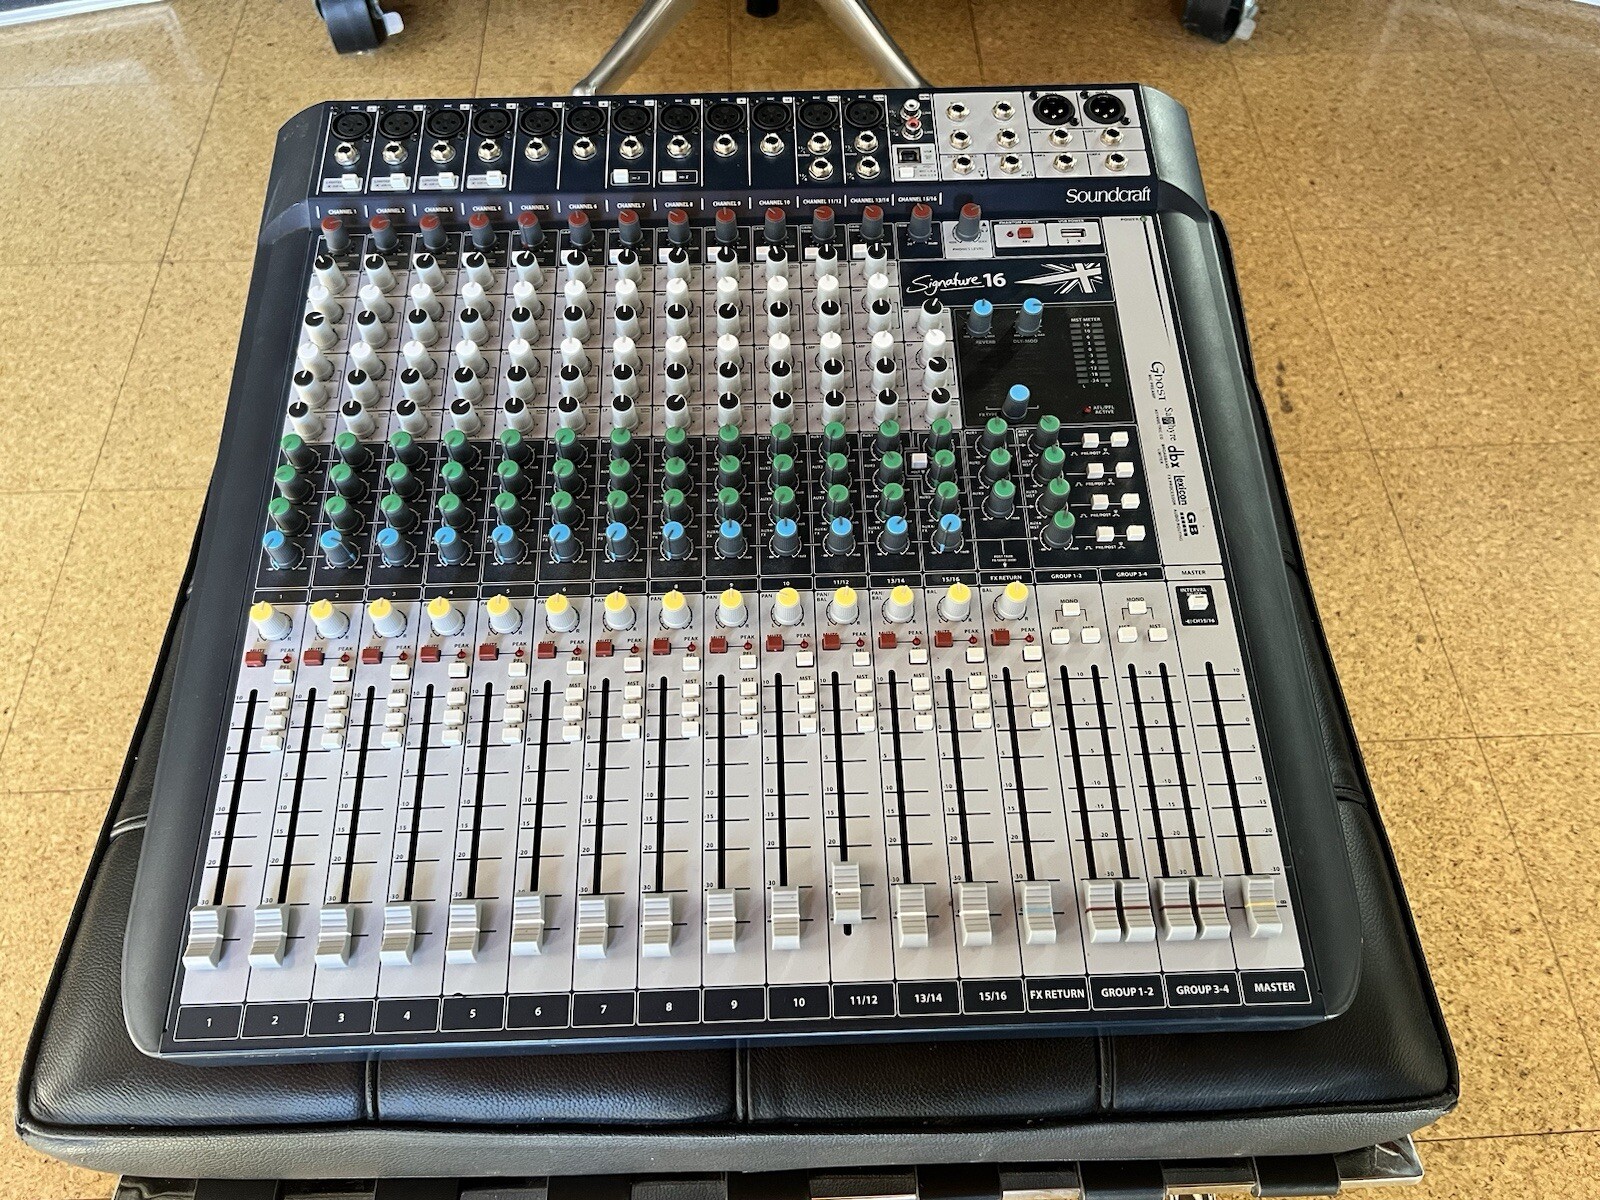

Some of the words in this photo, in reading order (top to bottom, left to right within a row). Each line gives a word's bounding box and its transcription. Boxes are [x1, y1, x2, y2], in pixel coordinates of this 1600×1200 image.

[1065, 186, 1151, 204] Soundcraft
[906, 273, 985, 296] Signature
[983, 273, 1006, 288] 16
[1168, 446, 1185, 468] dbx
[1174, 475, 1187, 505] lexicon
[1187, 512, 1199, 535] GB
[1101, 987, 1136, 997] GROUP
[1138, 987, 1154, 996] 1-2
[1176, 985, 1212, 995] GROUP
[1214, 984, 1229, 994] 3-4
[1254, 982, 1295, 992] MASTER
[914, 993, 942, 1003] 13/14
[979, 991, 1007, 1001] 15/16
[1030, 990, 1043, 999] FX
[1045, 989, 1085, 999] RETURN
[731, 1000, 738, 1010] 9
[793, 998, 805, 1008] 10
[850, 995, 878, 1005] 11/12
[535, 1007, 541, 1017] 6
[601, 1004, 607, 1014] 7
[666, 1002, 672, 1012] 8
[338, 1013, 345, 1023] 3
[403, 1011, 410, 1020] 4
[470, 1009, 476, 1018] 5
[207, 1018, 212, 1027] 1
[271, 1015, 278, 1025] 2
